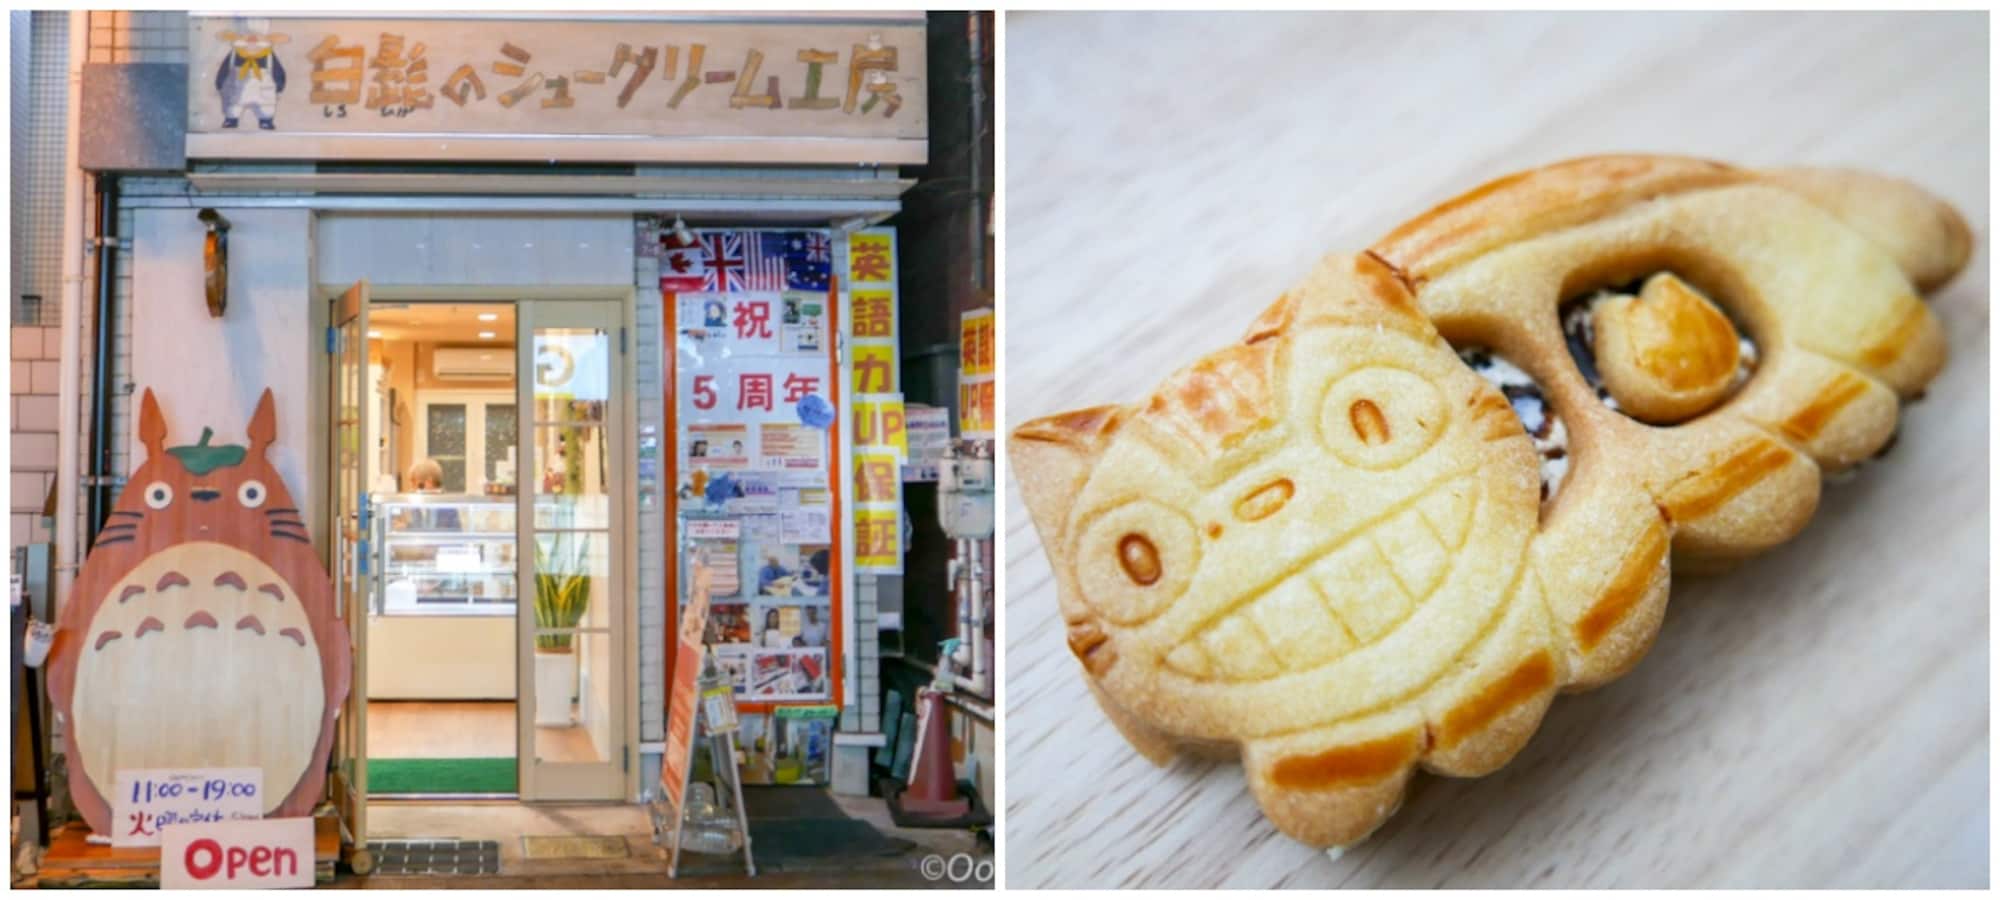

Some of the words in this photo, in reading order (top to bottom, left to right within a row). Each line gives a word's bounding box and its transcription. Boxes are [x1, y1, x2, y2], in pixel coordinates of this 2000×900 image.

[308, 32, 902, 117] 白髭のシュークリーム工房
[733, 301, 773, 340] 祝
[692, 373, 820, 413] 5周年
[184, 837, 298, 880] Open
